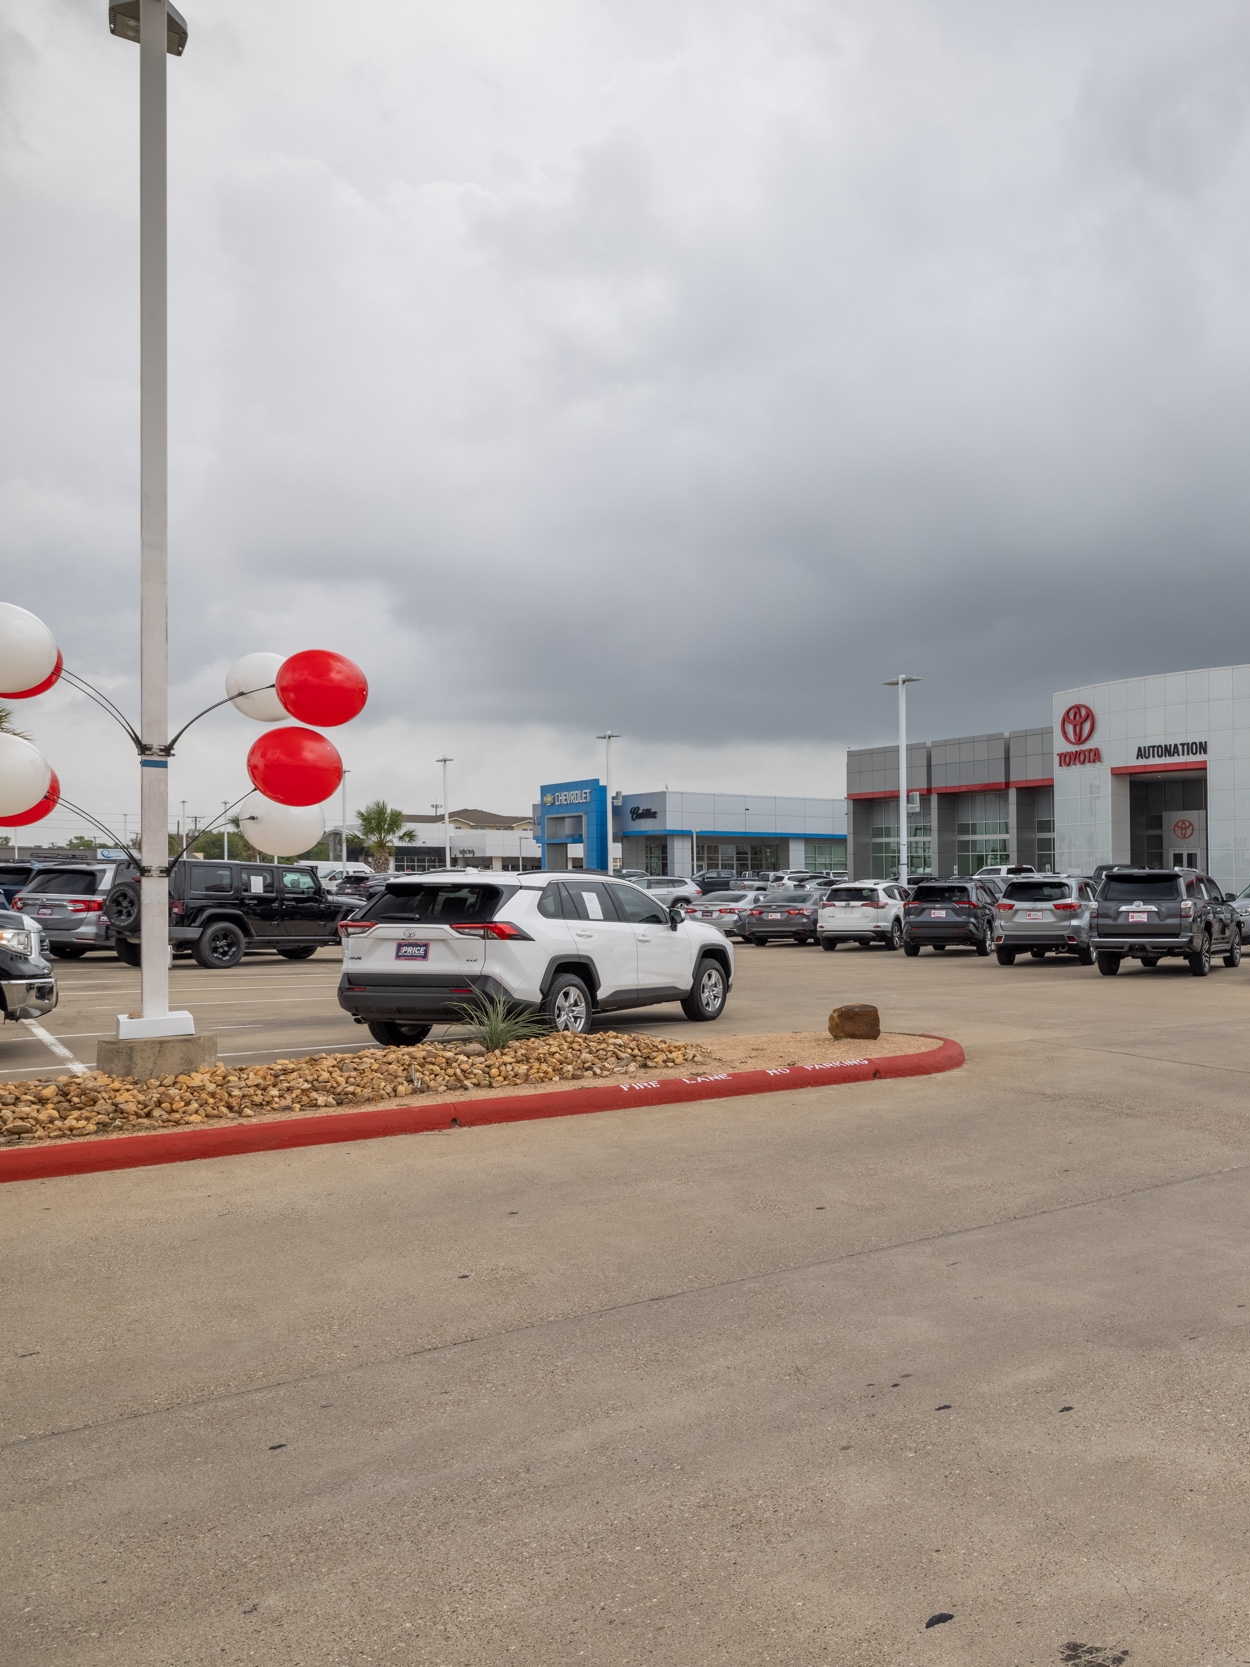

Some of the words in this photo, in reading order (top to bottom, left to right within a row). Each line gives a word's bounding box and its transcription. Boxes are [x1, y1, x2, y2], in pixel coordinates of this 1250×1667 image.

[1056, 747, 1102, 768] TOYOTA
[1136, 741, 1208, 760] AUTONATION
[554, 789, 591, 805] CHEVROLET
[629, 806, 658, 821] Cadillac
[619, 1080, 660, 1091] FIRE
[681, 1073, 733, 1084] LANE
[765, 1066, 791, 1076] NO
[803, 1058, 869, 1071] PARKING
